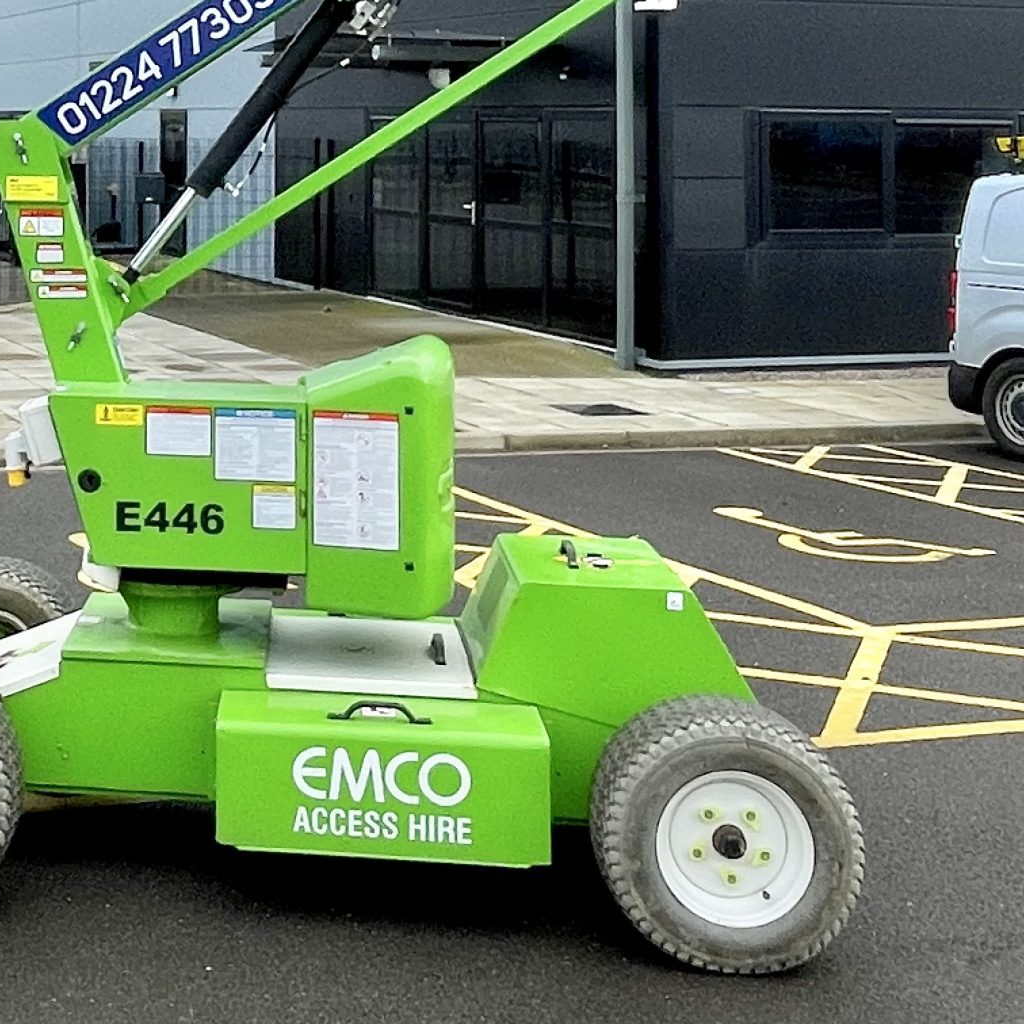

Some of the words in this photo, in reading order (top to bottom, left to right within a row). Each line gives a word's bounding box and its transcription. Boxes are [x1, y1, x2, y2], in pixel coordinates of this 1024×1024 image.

[57, 50, 163, 135] 01224
[116, 501, 225, 535] E446
[292, 746, 472, 807] EMCO
[292, 805, 399, 840] ACCESS
[408, 813, 473, 845] HIRE
